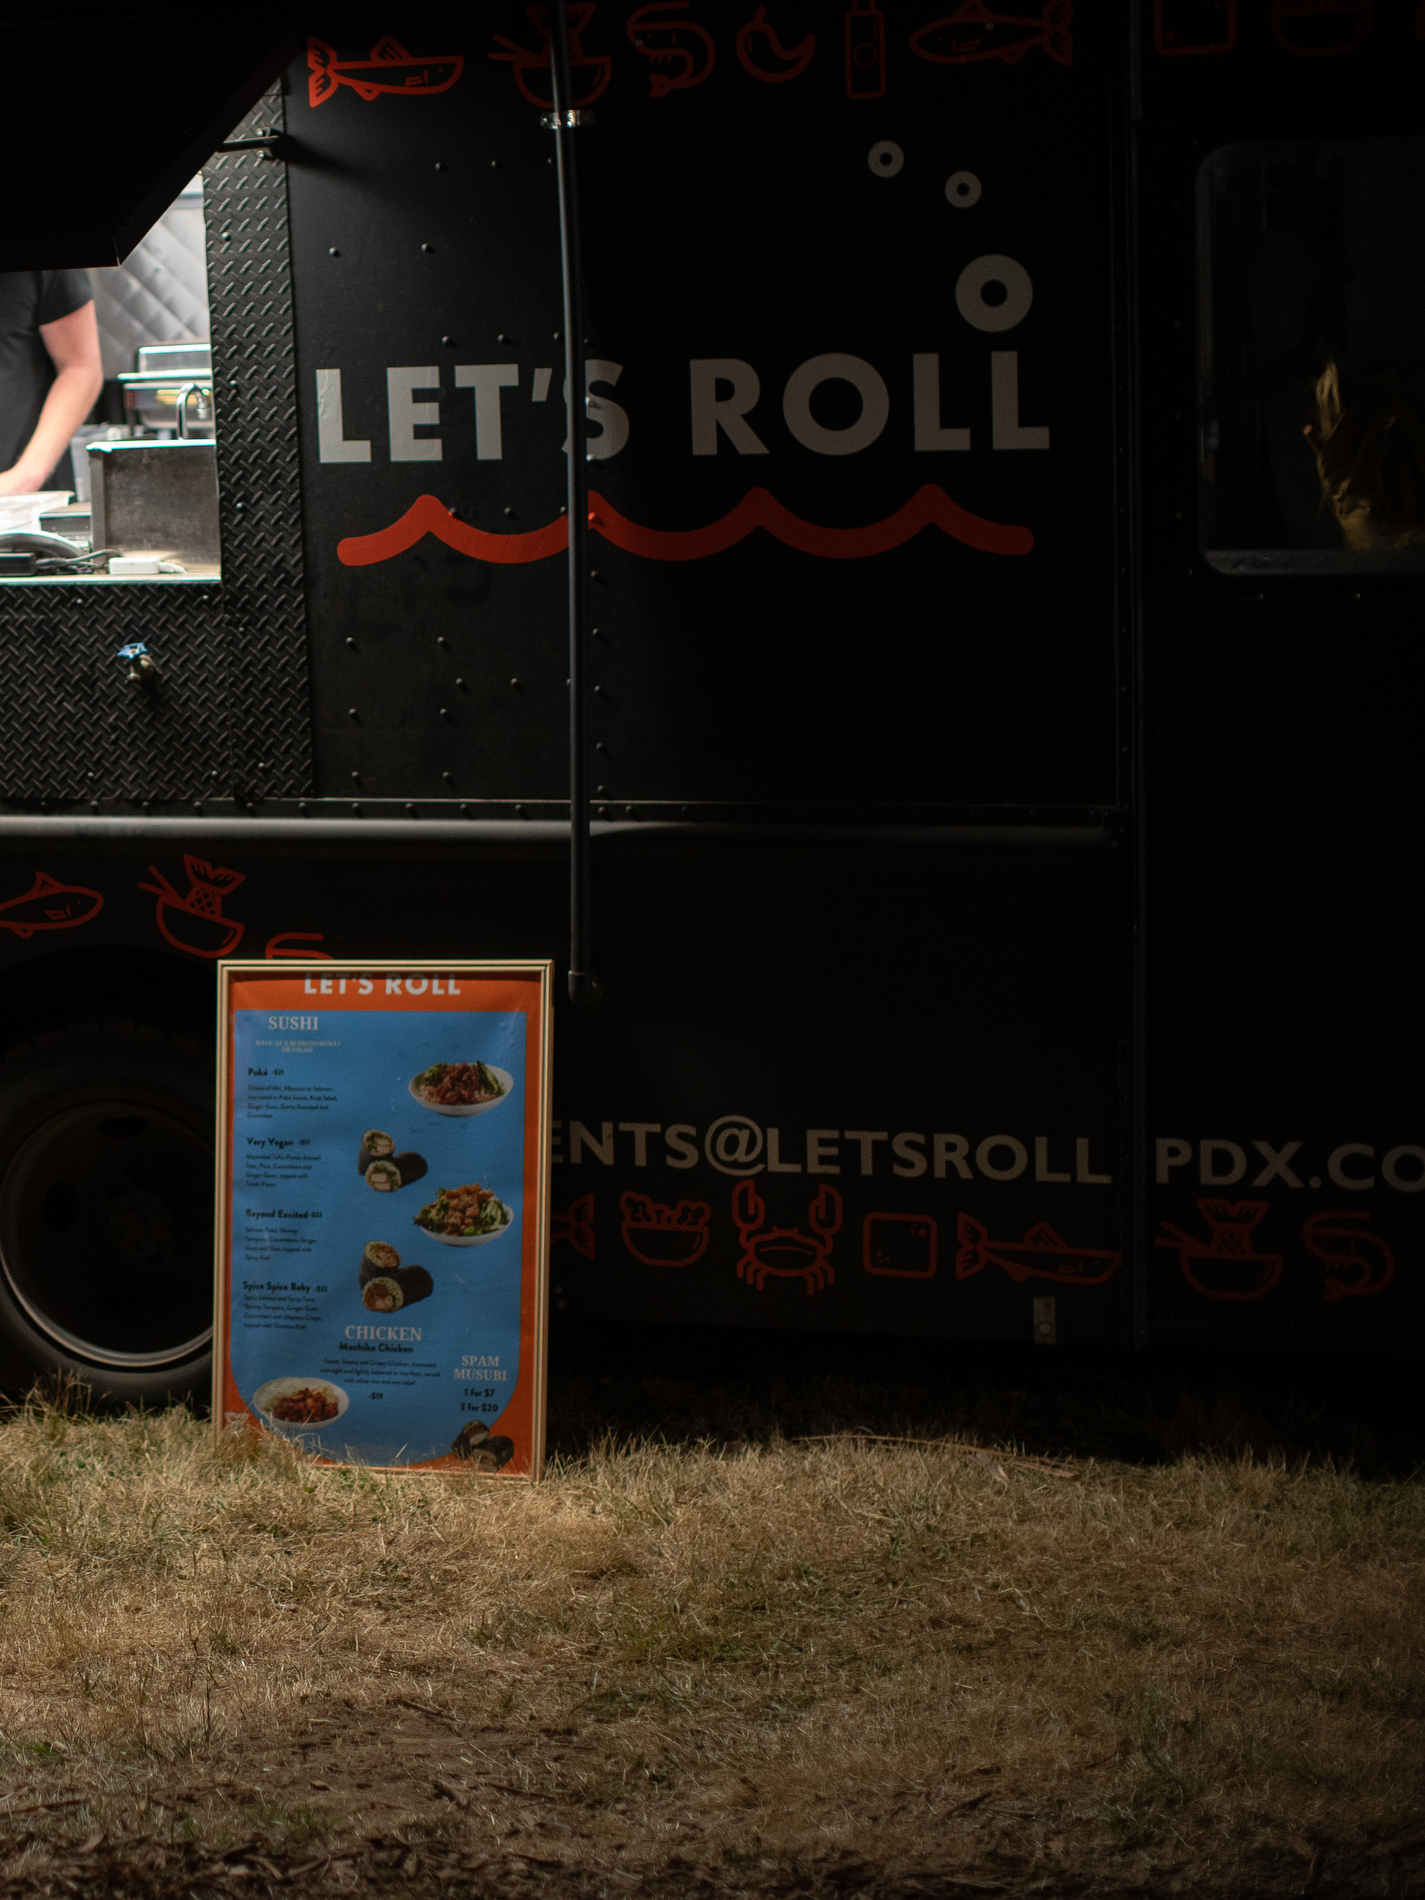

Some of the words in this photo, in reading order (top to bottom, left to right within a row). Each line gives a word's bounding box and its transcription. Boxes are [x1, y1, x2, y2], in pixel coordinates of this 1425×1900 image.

[315, 358, 630, 463] LET'S
[689, 350, 1050, 457] ROLL
[304, 972, 374, 996] LET'S
[385, 972, 461, 996] ROLL
[267, 1015, 320, 1031] SUSHI
[247, 1136, 266, 1149] Very
[268, 1136, 294, 1150] Vegan
[552, 1114, 1113, 1185] ENTS@LETSROLL
[1155, 1137, 1425, 1193] PDX.CO
[246, 1208, 276, 1220] Beyond
[291, 1282, 311, 1295] Baby
[345, 1325, 422, 1341] CHICKEN
[339, 1342, 376, 1352] Mochiko
[378, 1342, 414, 1353] Chicken
[461, 1354, 500, 1367] SPAM
[454, 1368, 507, 1382] MUSUBI
[464, 1388, 469, 1397] 1
[470, 1387, 482, 1397] for
[484, 1388, 495, 1398] $7
[467, 1402, 479, 1412] for
[481, 1403, 499, 1412] $20
